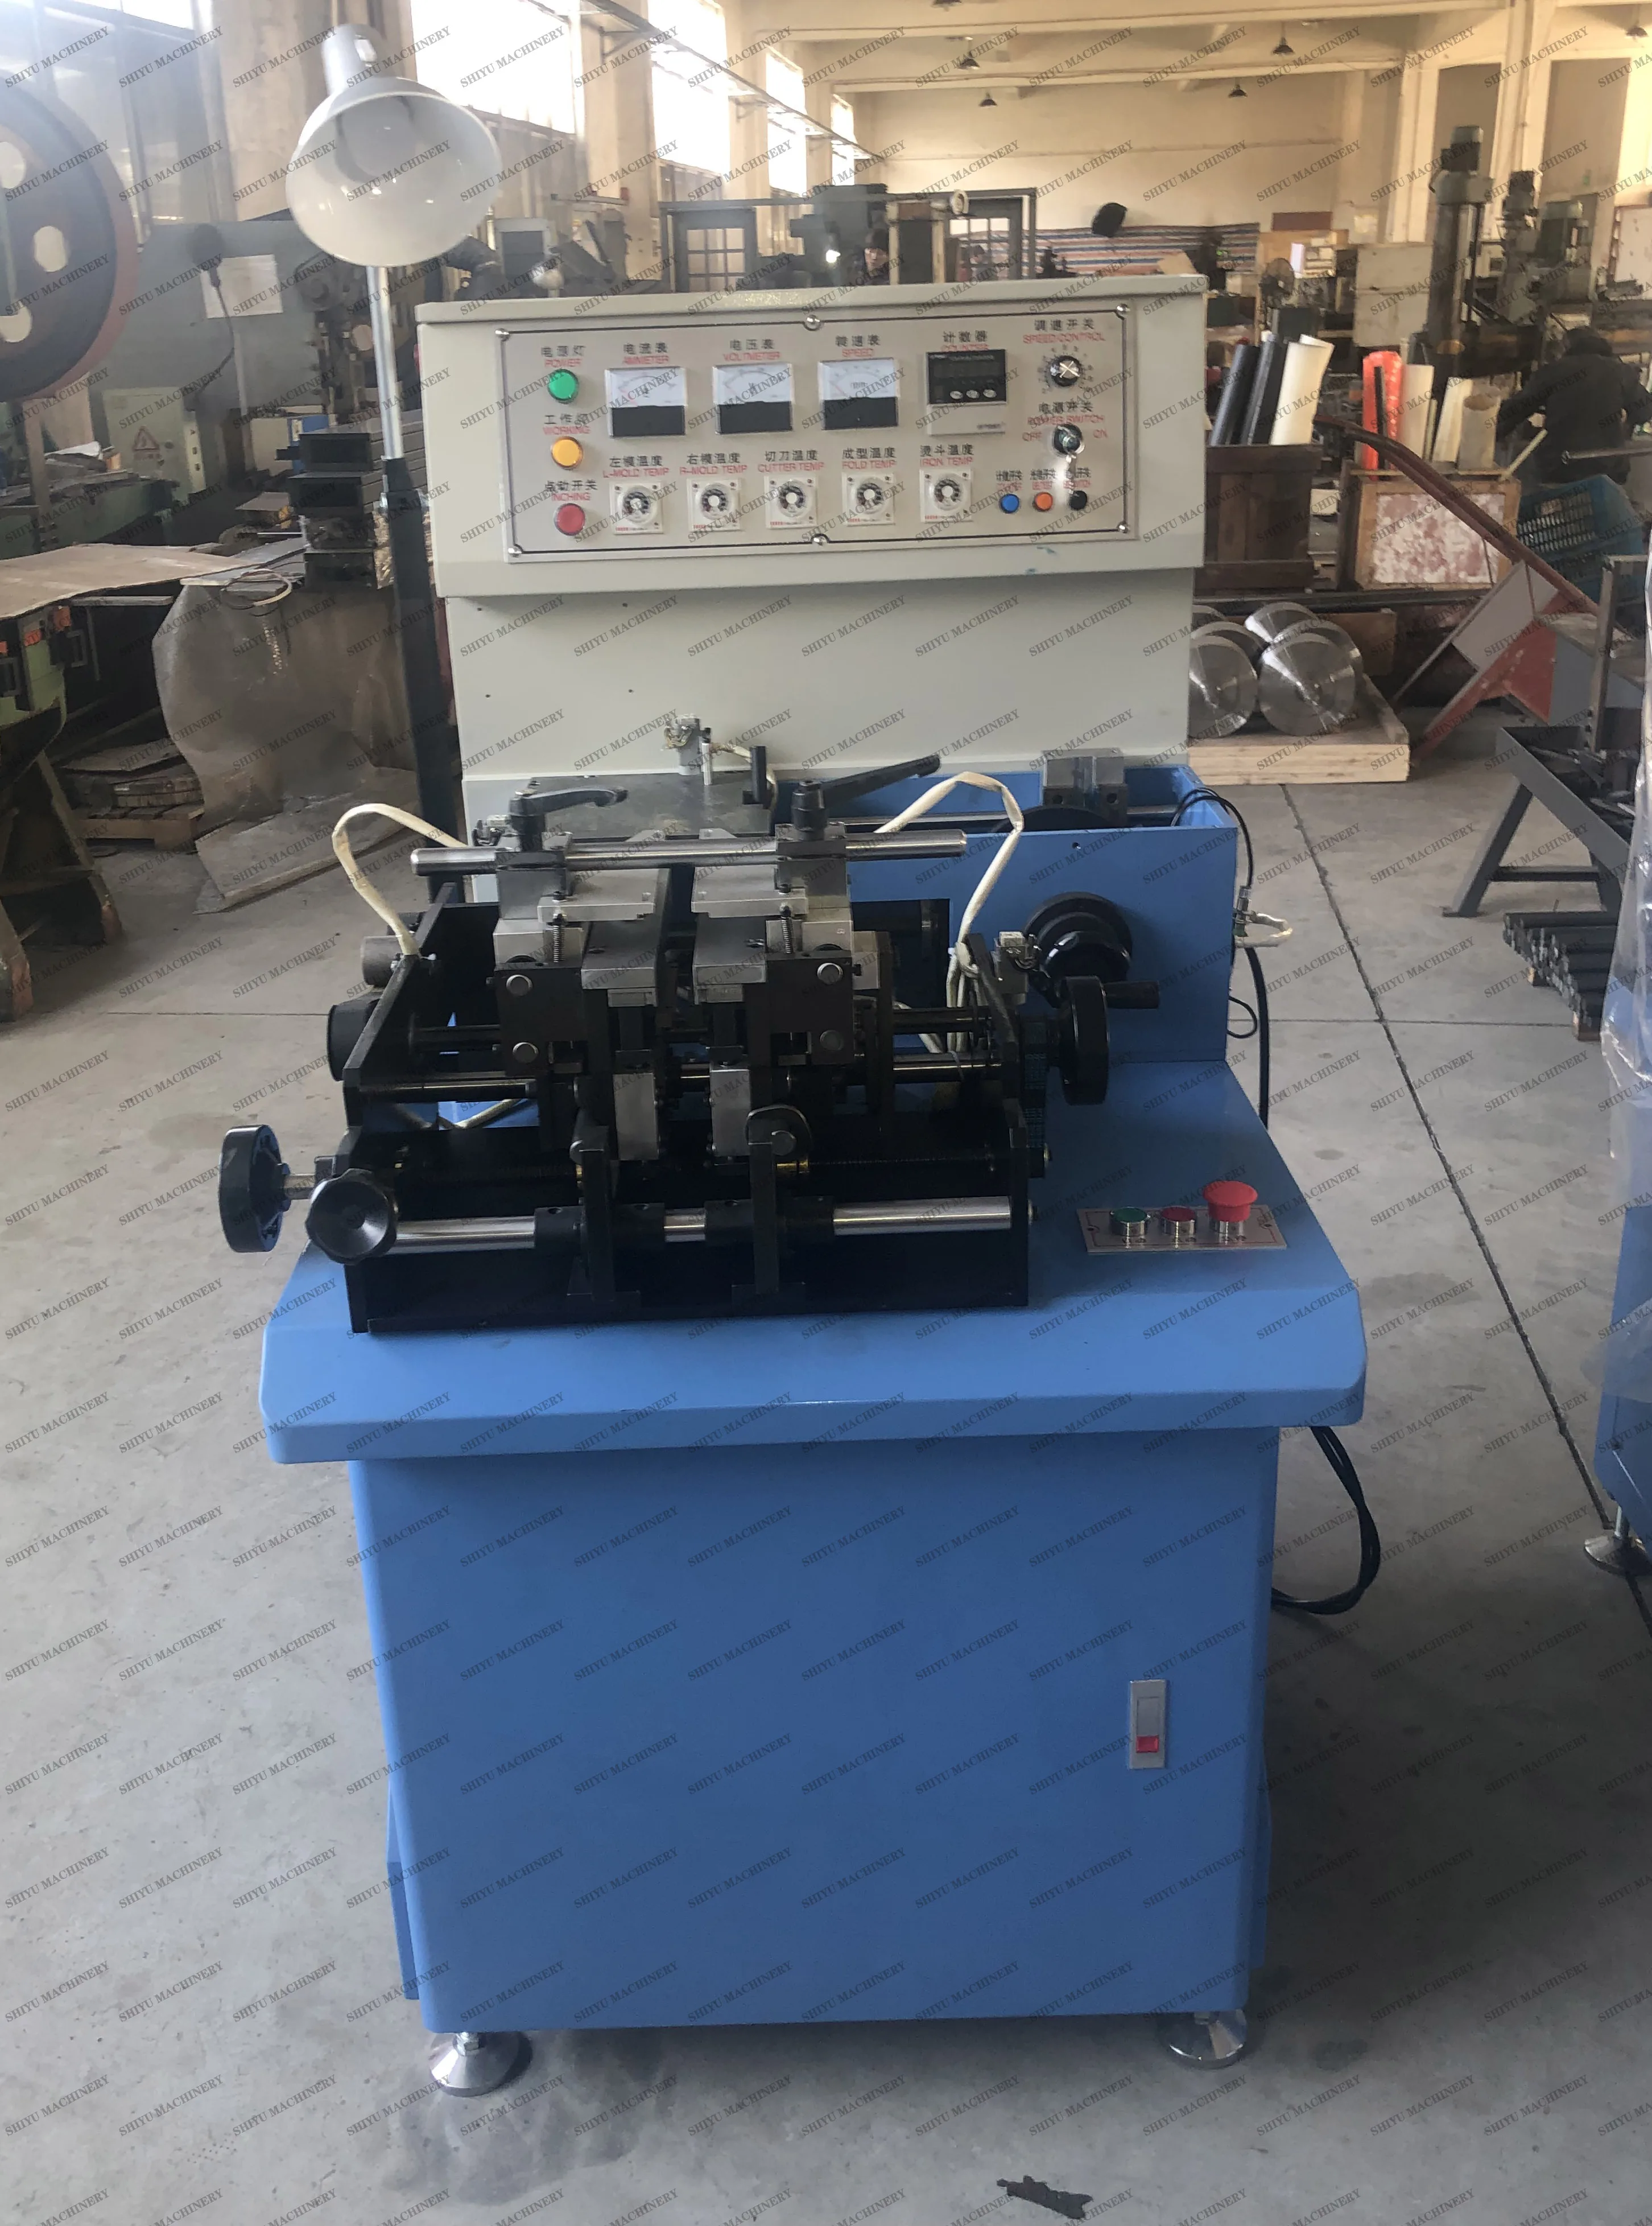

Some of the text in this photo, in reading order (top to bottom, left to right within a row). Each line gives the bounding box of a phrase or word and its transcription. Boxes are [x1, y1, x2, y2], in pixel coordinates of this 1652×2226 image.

[729, 339, 775, 351] 电压表
[723, 351, 780, 361] VOLTMETER
[842, 348, 874, 357] SPEED
[544, 358, 583, 368] POWER
[543, 425, 591, 435] WORKING
[1093, 428, 1108, 439] ON
[1022, 431, 1042, 442] OFF
[686, 453, 741, 464] 右模温度
[765, 449, 818, 461] 切刀温度
[842, 447, 897, 459] 成型温度
[609, 455, 663, 467] 左模温度
[842, 459, 898, 469] FOLD TEMP
[920, 456, 974, 467] IRON TEMP
[603, 467, 670, 478] L-MOLD TEMP
[679, 464, 748, 475] R-MOLD TEMP
[758, 461, 825, 473] CUTTER TEMP
[552, 491, 590, 501] INCHING
